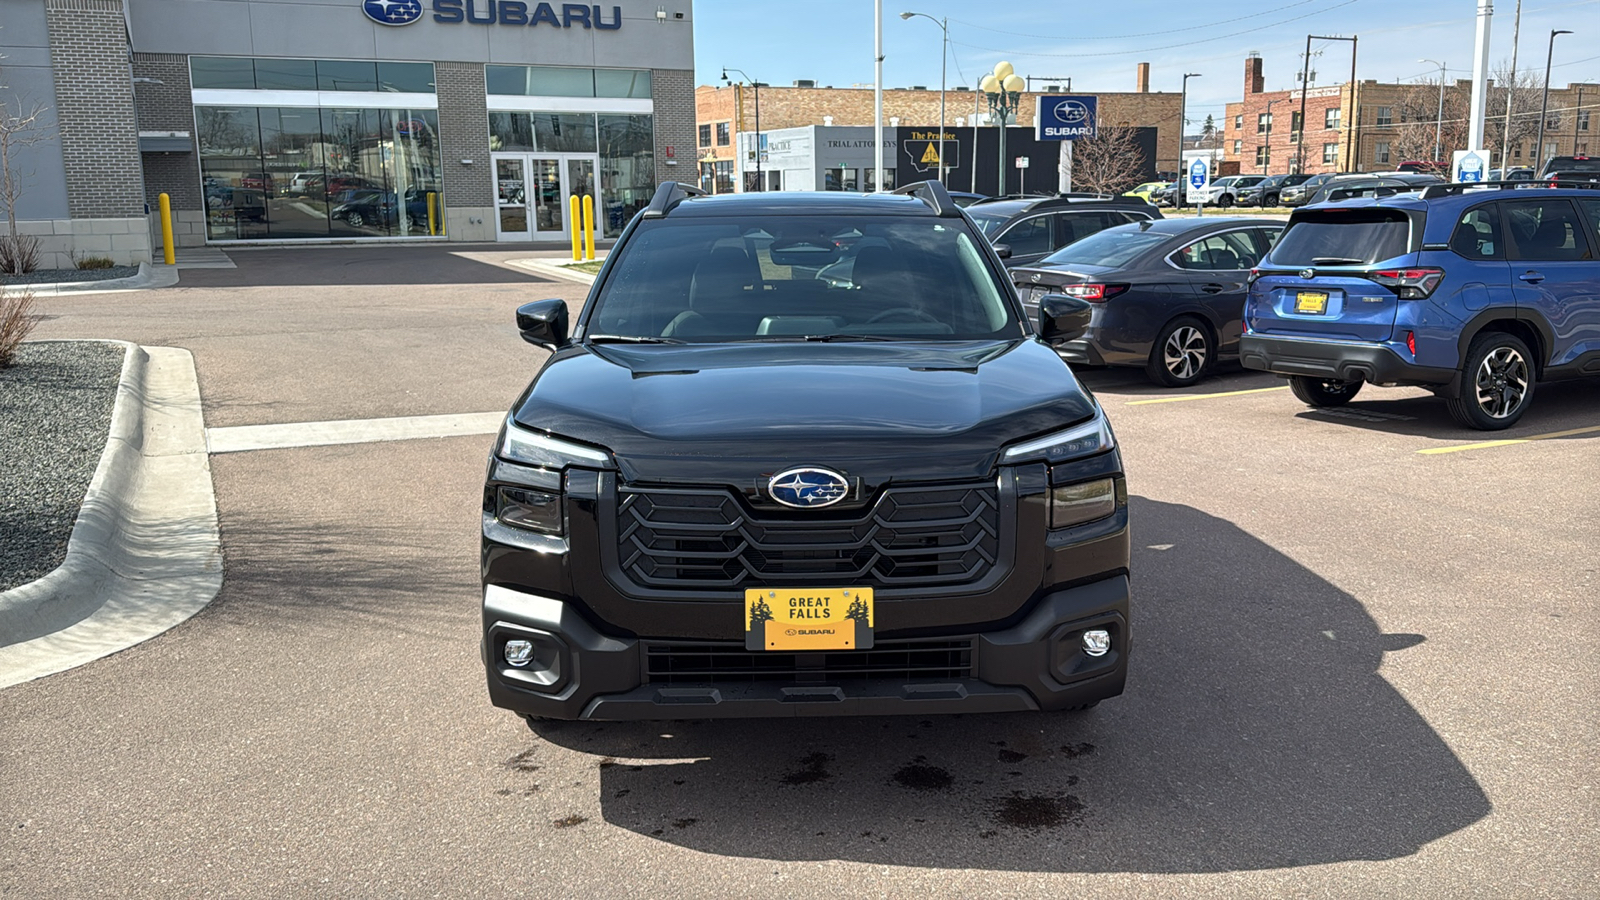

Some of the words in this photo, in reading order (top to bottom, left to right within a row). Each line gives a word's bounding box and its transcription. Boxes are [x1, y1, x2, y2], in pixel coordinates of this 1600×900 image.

[433, 0, 622, 30] SUBARU
[911, 131, 926, 140] The
[927, 131, 956, 140] Pratice
[1045, 127, 1093, 136] SUBARU
[768, 140, 791, 151] PRACTICE
[827, 140, 851, 148] TRIAL
[852, 140, 897, 148] ATTOEYS
[789, 597, 830, 607] GREAT
[789, 608, 830, 619] FALLS
